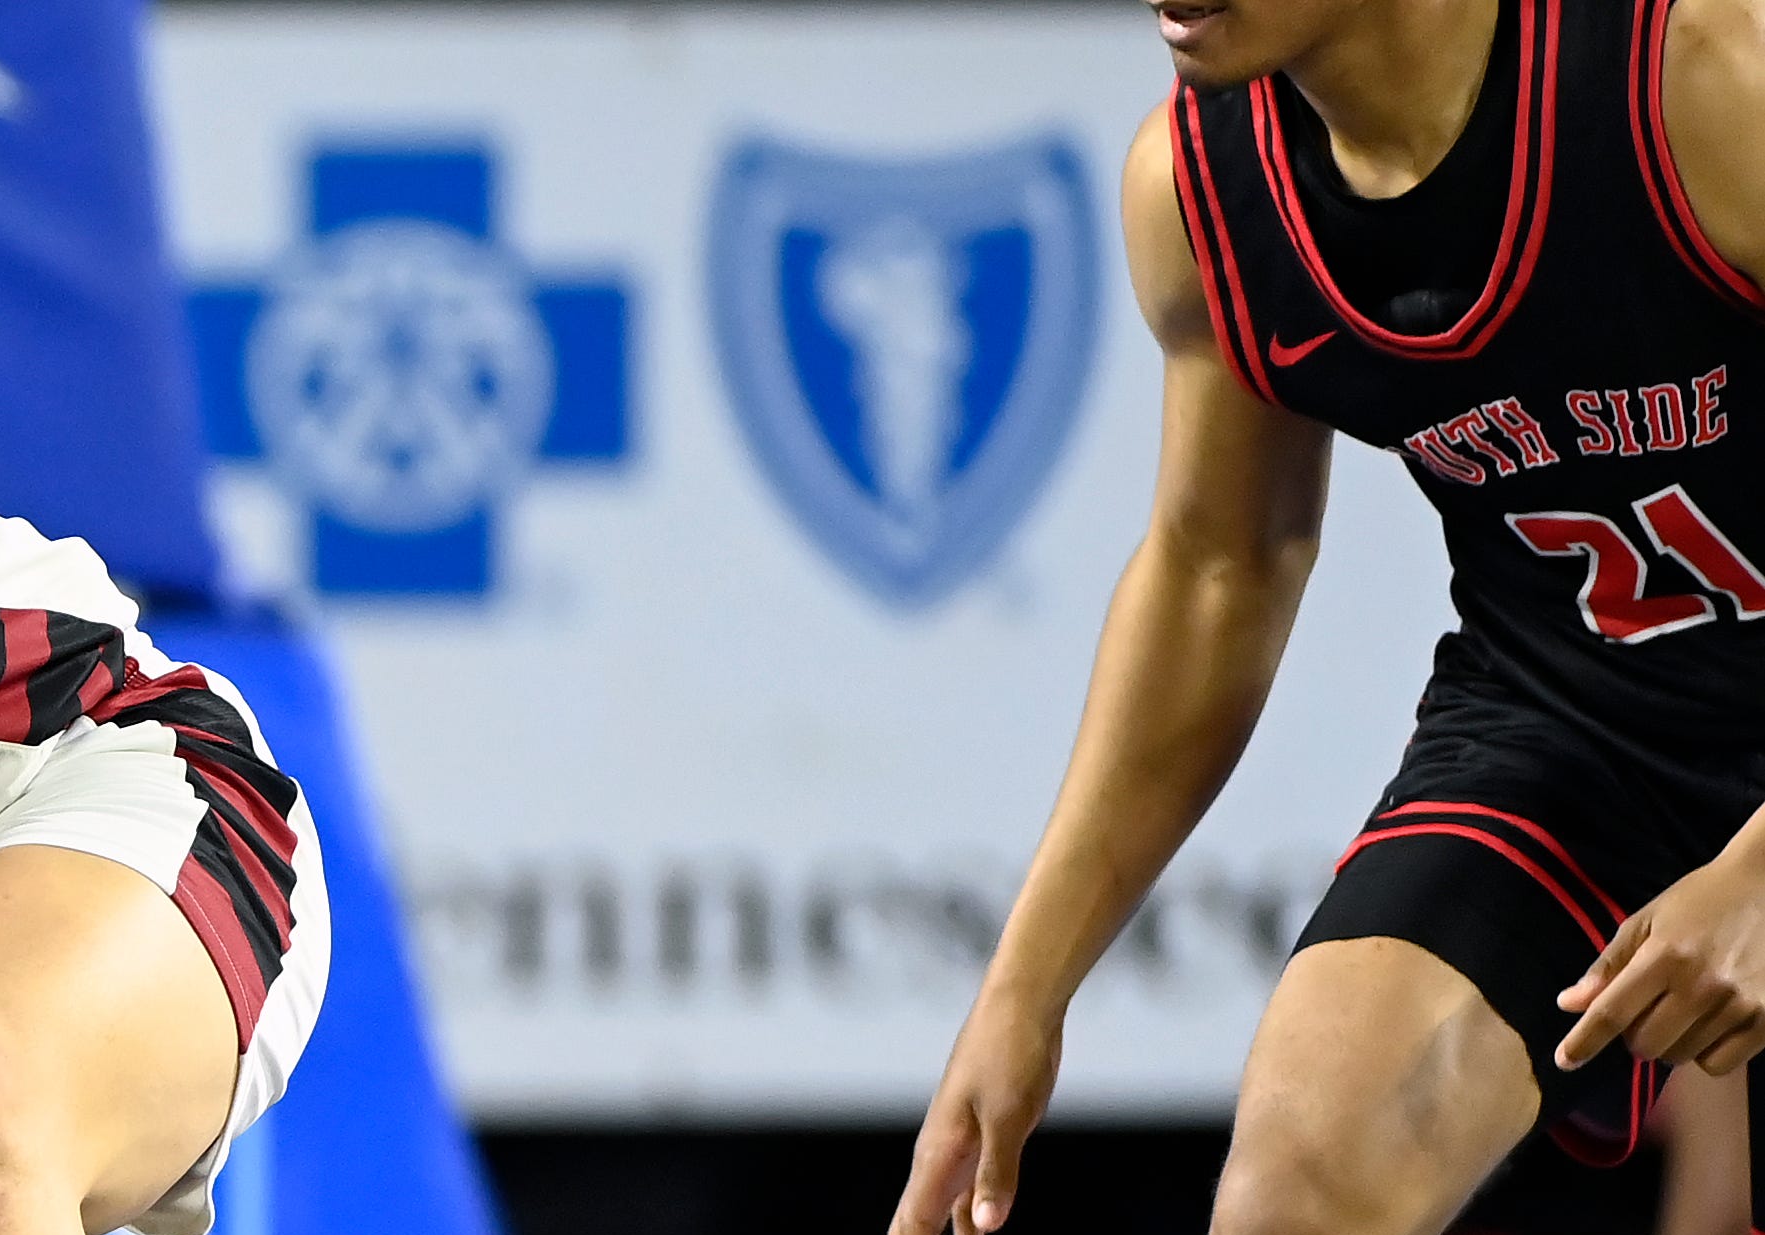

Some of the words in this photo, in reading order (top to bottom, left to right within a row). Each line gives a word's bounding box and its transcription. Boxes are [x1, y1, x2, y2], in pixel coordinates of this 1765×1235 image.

[1403, 395, 1561, 487] UTH
[1565, 363, 1729, 457] SIDE
[1503, 482, 1765, 645] 21
